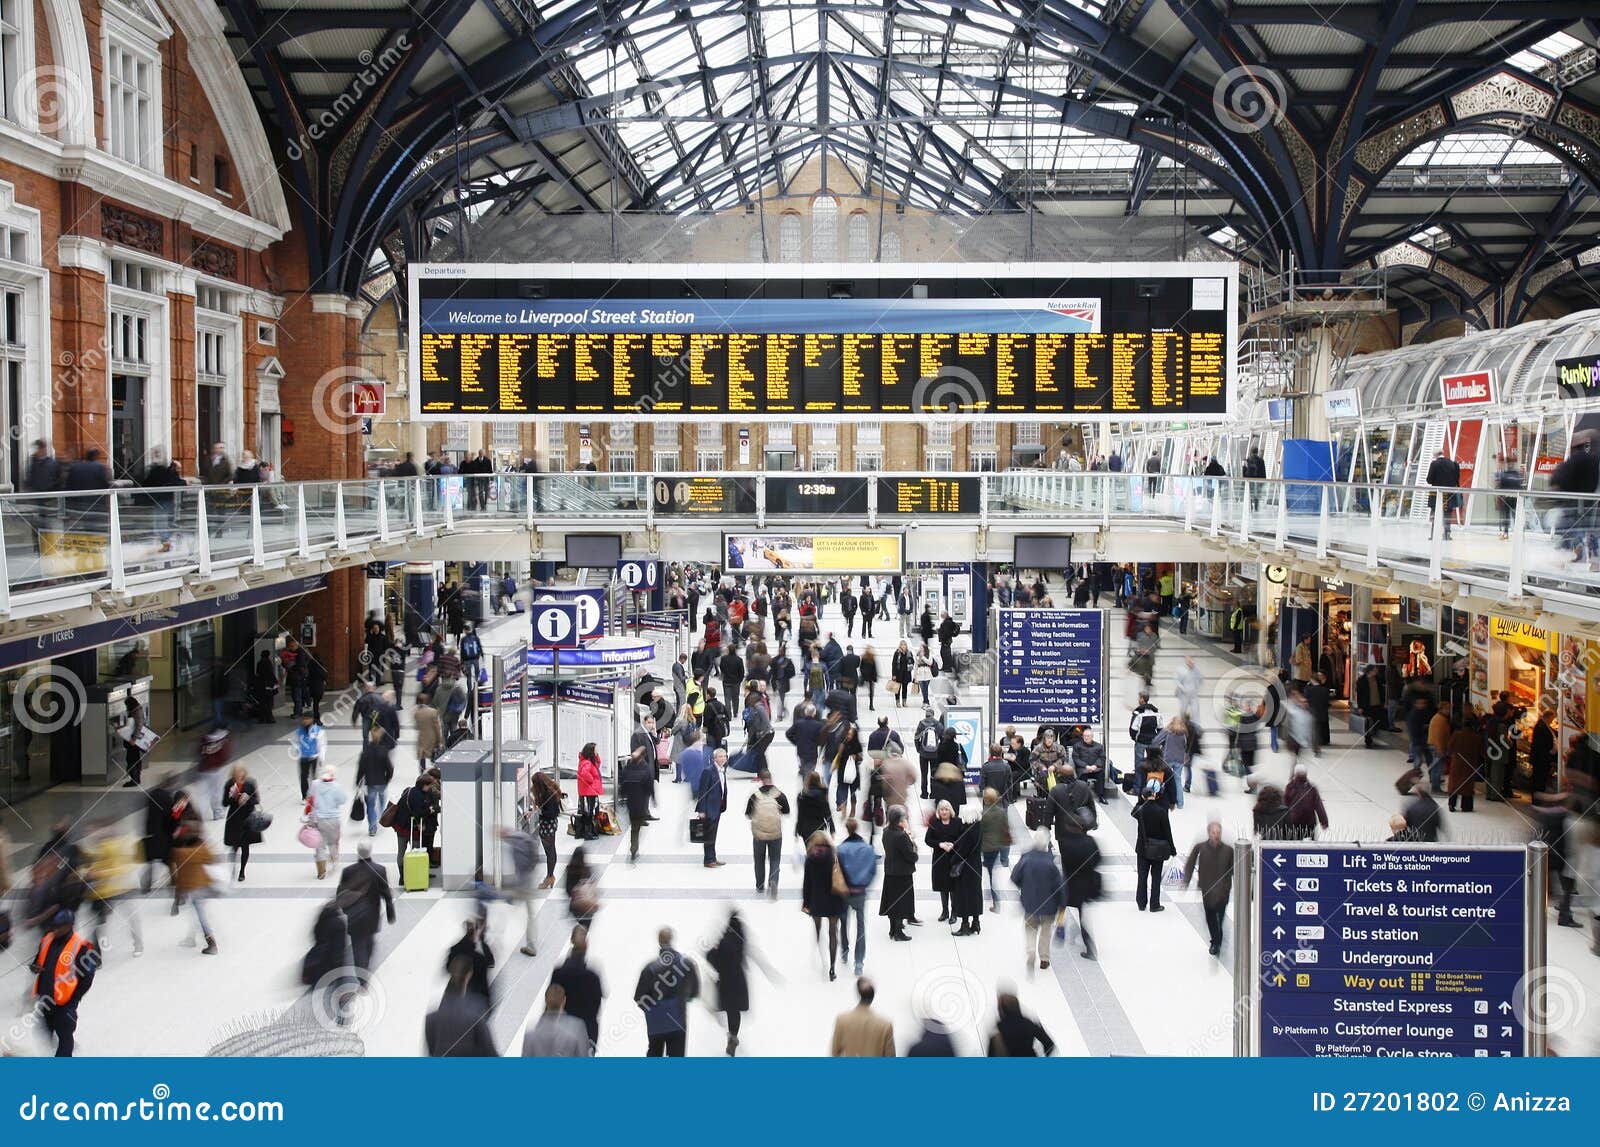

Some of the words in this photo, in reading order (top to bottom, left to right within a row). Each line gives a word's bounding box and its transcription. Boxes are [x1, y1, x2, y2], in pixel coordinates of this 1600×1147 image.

[424, 266, 466, 275] Departures
[449, 312, 502, 324] Welcome
[506, 313, 516, 324] to
[520, 310, 588, 327] Liverpool
[591, 310, 636, 324] Street
[640, 310, 694, 324] Station
[1446, 380, 1487, 400] Ladbrokes
[602, 649, 650, 662] Information
[1342, 855, 1367, 868] Lift
[1384, 854, 1400, 863] Way
[1420, 854, 1470, 864] Underground
[1344, 879, 1392, 892] Tickets
[1397, 880, 1408, 892] &
[1412, 880, 1492, 894] information
[1343, 903, 1383, 916] Travel
[1388, 904, 1398, 916] &
[1402, 905, 1448, 917] tourist
[1451, 906, 1496, 918] centre
[1342, 927, 1368, 940] Bus
[1372, 928, 1418, 940] station
[1342, 950, 1433, 967] Underground
[1343, 975, 1375, 990] Way
[1380, 976, 1404, 988] out
[1333, 998, 1394, 1012] Stansted
[1399, 1000, 1452, 1015] Express
[1273, 1026, 1283, 1035] By
[1335, 1022, 1402, 1036] Customer
[1407, 1024, 1454, 1040] lounge
[1316, 1044, 1326, 1053] By
[1328, 1044, 1360, 1052] Platform
[1376, 1047, 1414, 1057] Cycle
[1418, 1049, 1452, 1057] store
